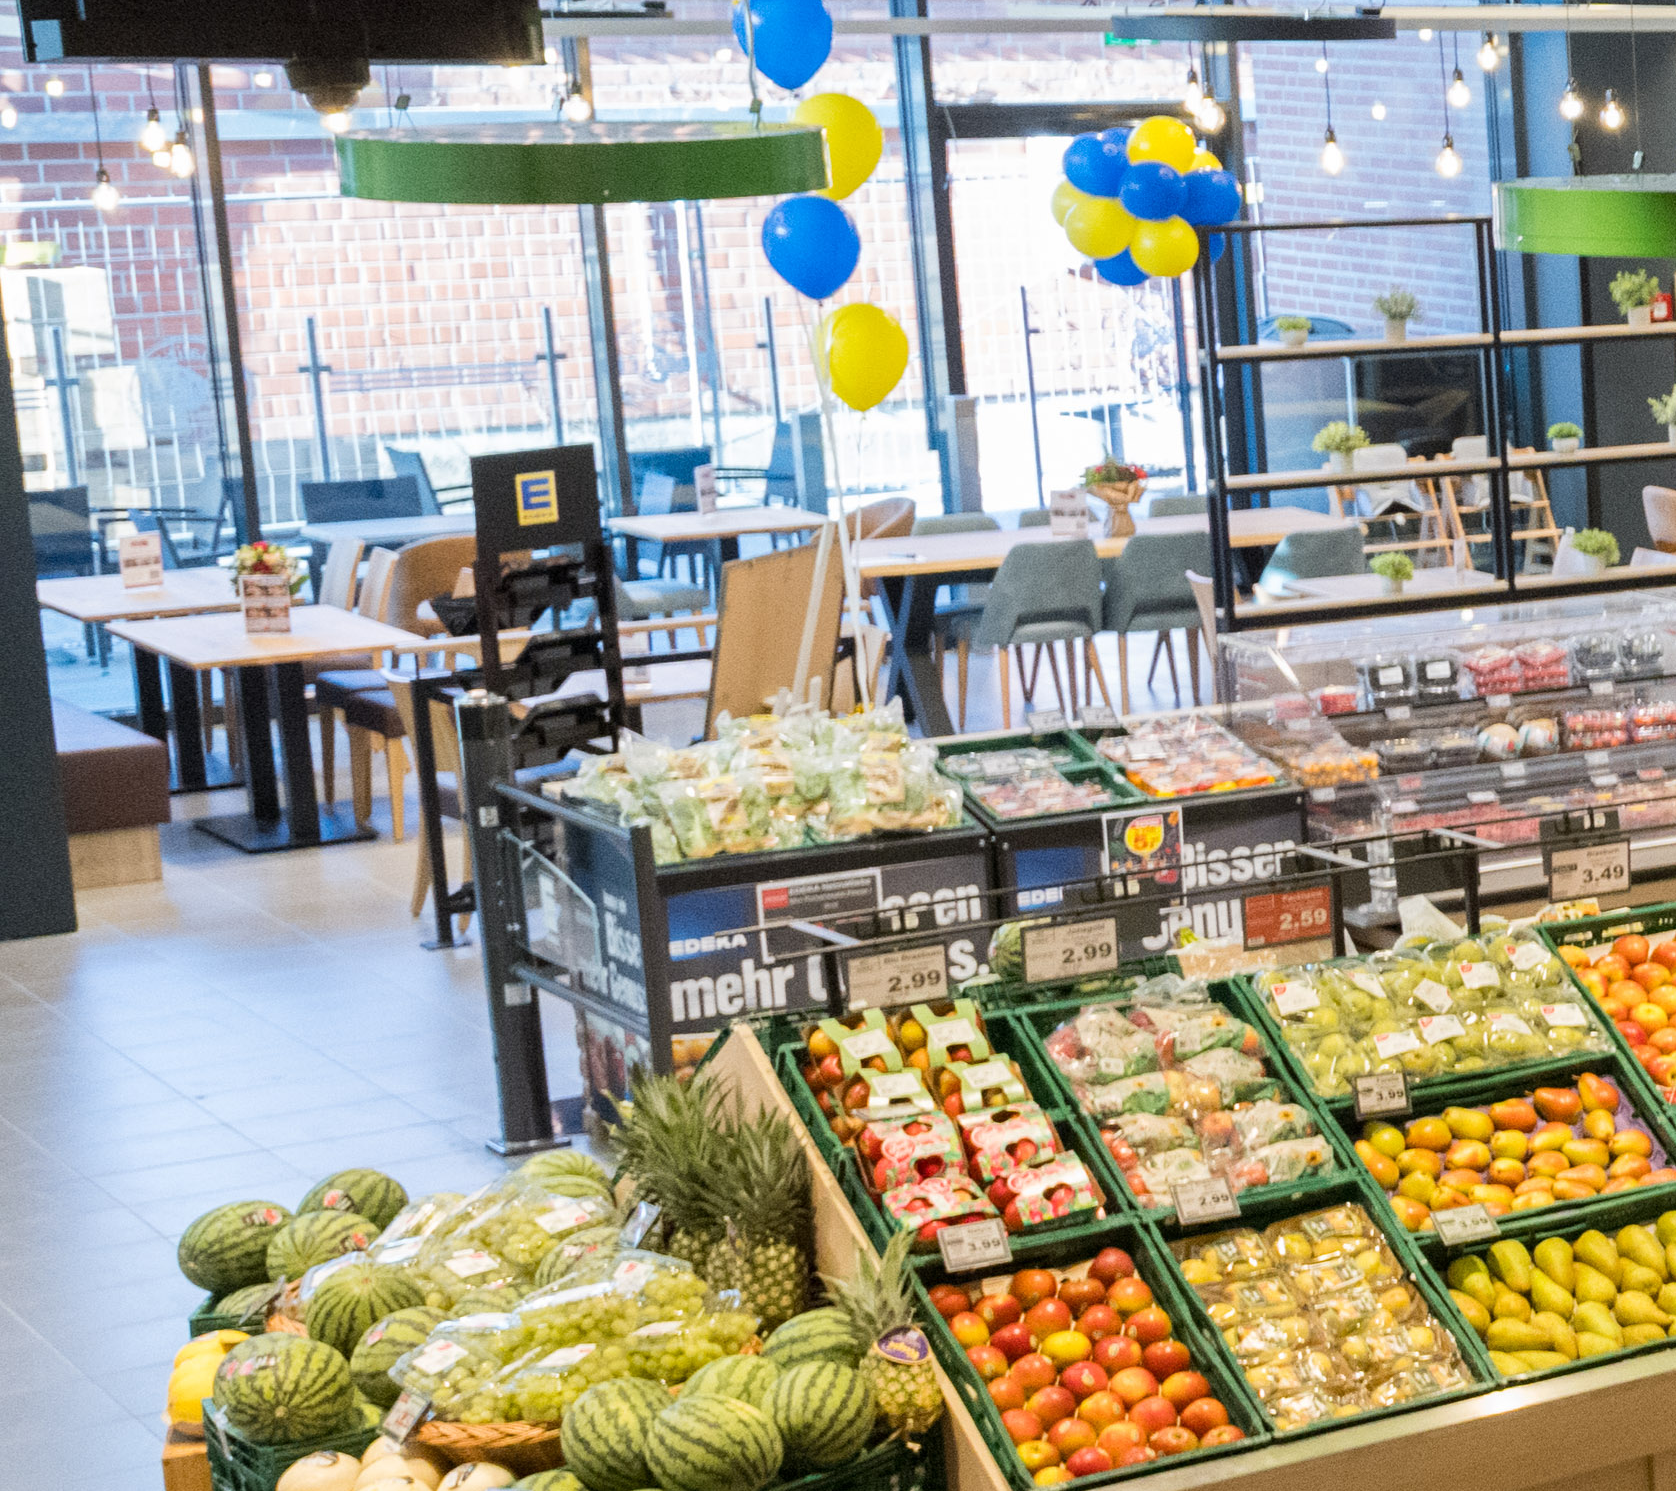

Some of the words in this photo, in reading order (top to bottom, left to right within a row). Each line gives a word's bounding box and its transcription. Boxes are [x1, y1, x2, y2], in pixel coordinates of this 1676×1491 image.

[1583, 863, 1624, 882] 3.49
[1280, 909, 1327, 931] 2.59
[1062, 942, 1112, 964] 2.99
[670, 956, 795, 1022] mehr
[888, 970, 941, 993] 2.99
